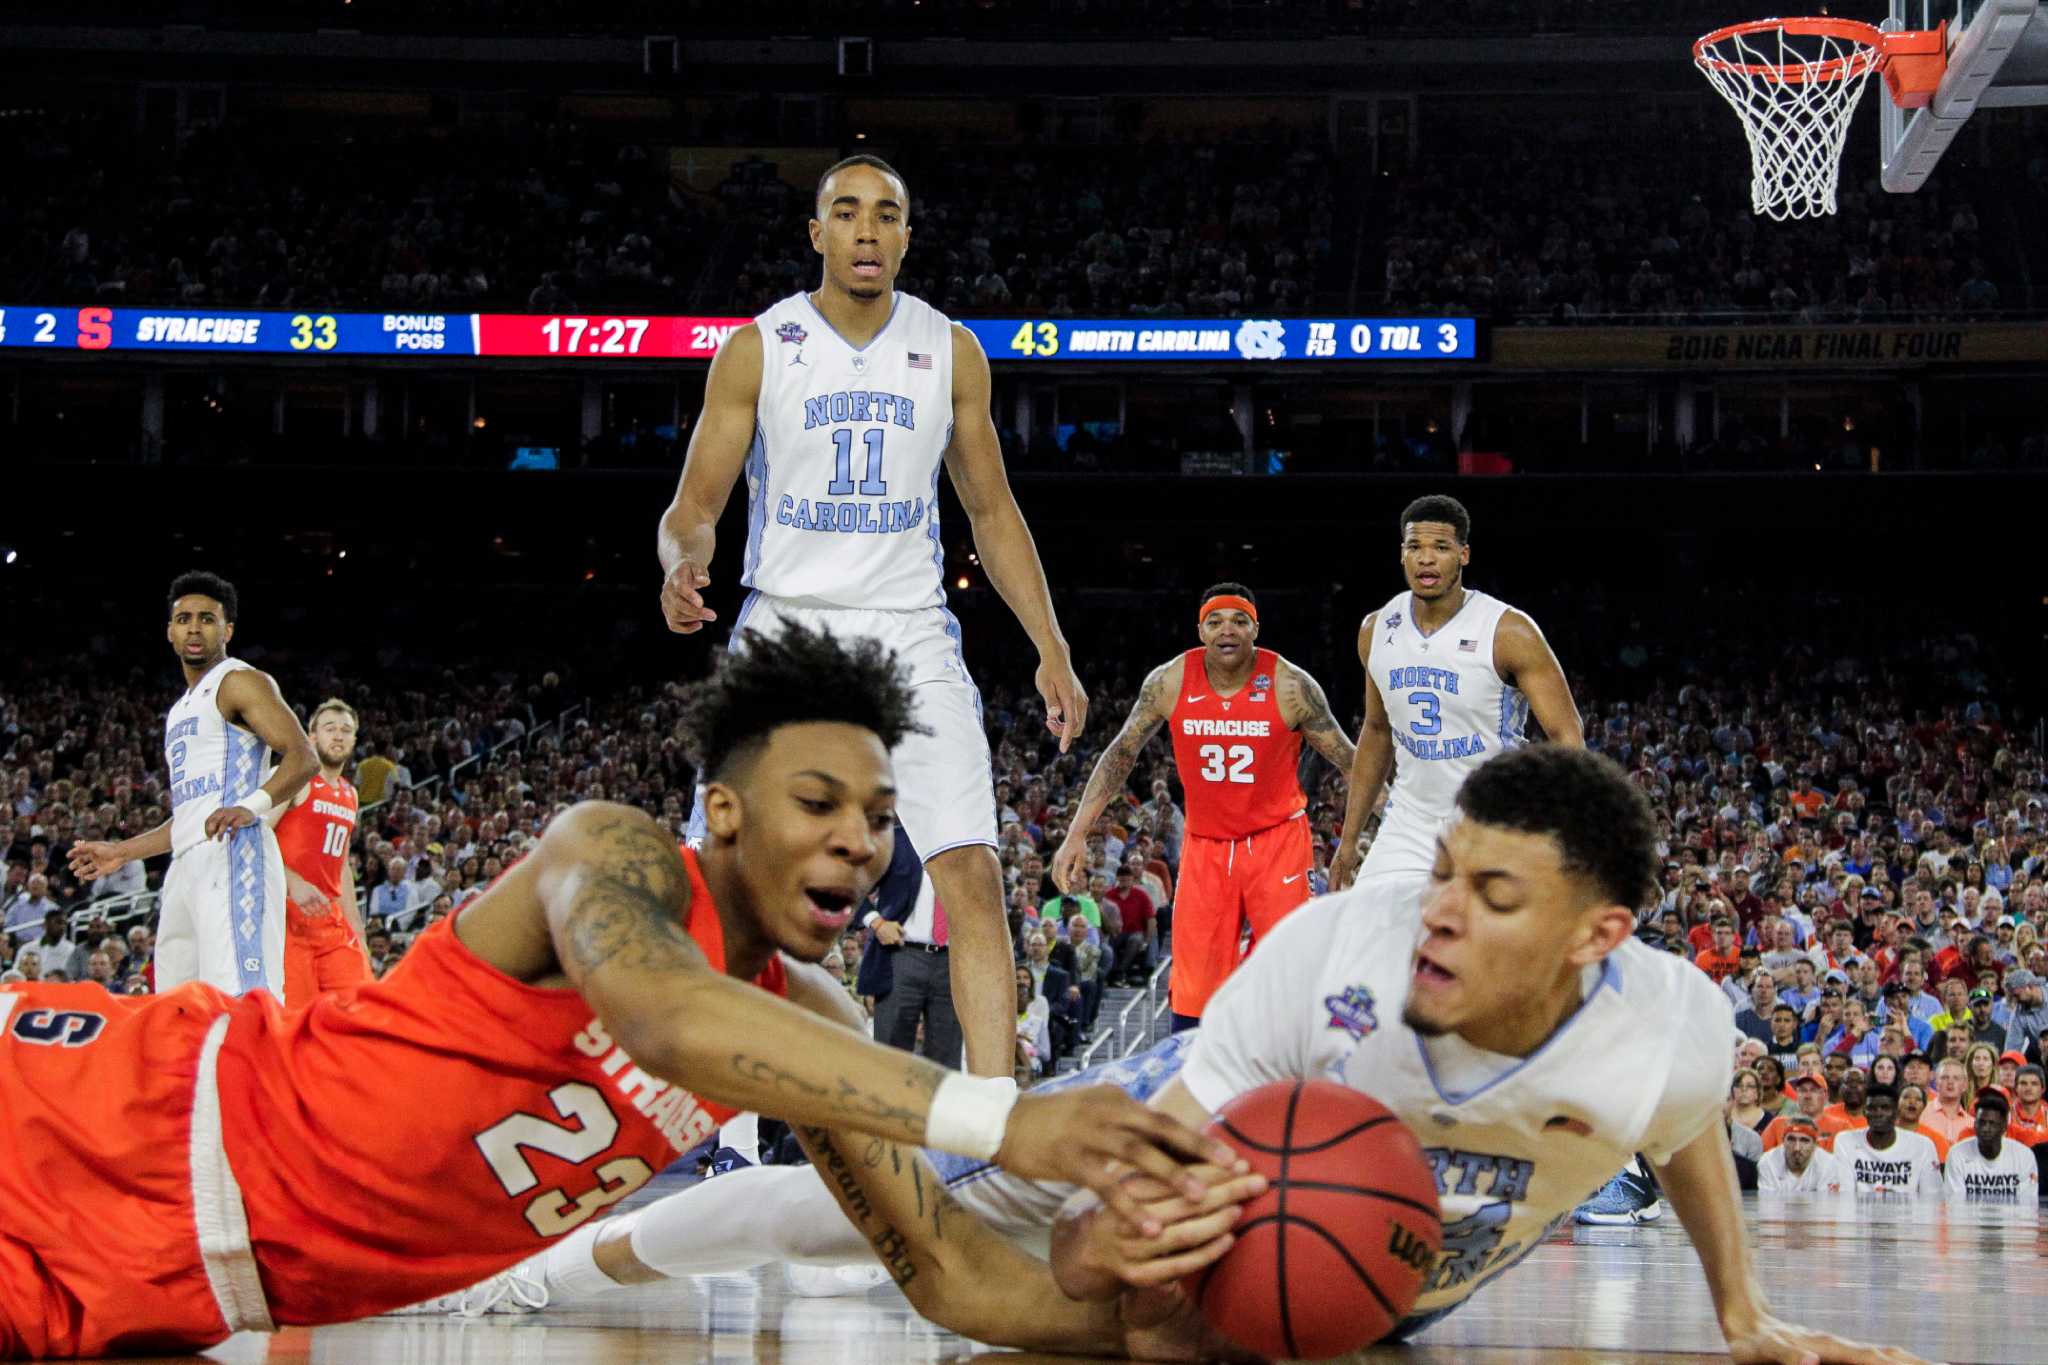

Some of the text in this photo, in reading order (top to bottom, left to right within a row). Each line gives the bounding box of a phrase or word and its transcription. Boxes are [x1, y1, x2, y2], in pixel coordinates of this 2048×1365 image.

[33, 313, 57, 342] 2
[77, 307, 113, 350] S
[137, 317, 261, 344] SYRACUSE
[290, 316, 337, 350] 33
[383, 315, 446, 331] BONUS
[542, 319, 649, 353] 17:27
[1011, 321, 1059, 356] 43
[1351, 324, 1372, 354] 0
[1379, 326, 1422, 351] TOL
[1438, 323, 1459, 353] 3
[396, 334, 445, 349] POSS
[1069, 330, 1230, 352] NORTH CAROLINA
[1666, 331, 1962, 361] 2016 NCAA FINAL FOUR
[804, 391, 915, 430] NORTH
[828, 428, 887, 496] 11
[776, 494, 925, 533] CAROLINA
[1389, 666, 1459, 695] NORTH
[1183, 719, 1270, 737] SYRACUSE
[1408, 691, 1442, 735] 3
[171, 740, 187, 785] 2
[1200, 744, 1255, 784] 32
[322, 822, 348, 857] 10
[473, 1082, 655, 1237] 23
[1424, 1147, 1535, 1201] RTH
[1854, 1158, 1912, 1173] ALWAYS
[1964, 1174, 2020, 1186] ALWAYS
